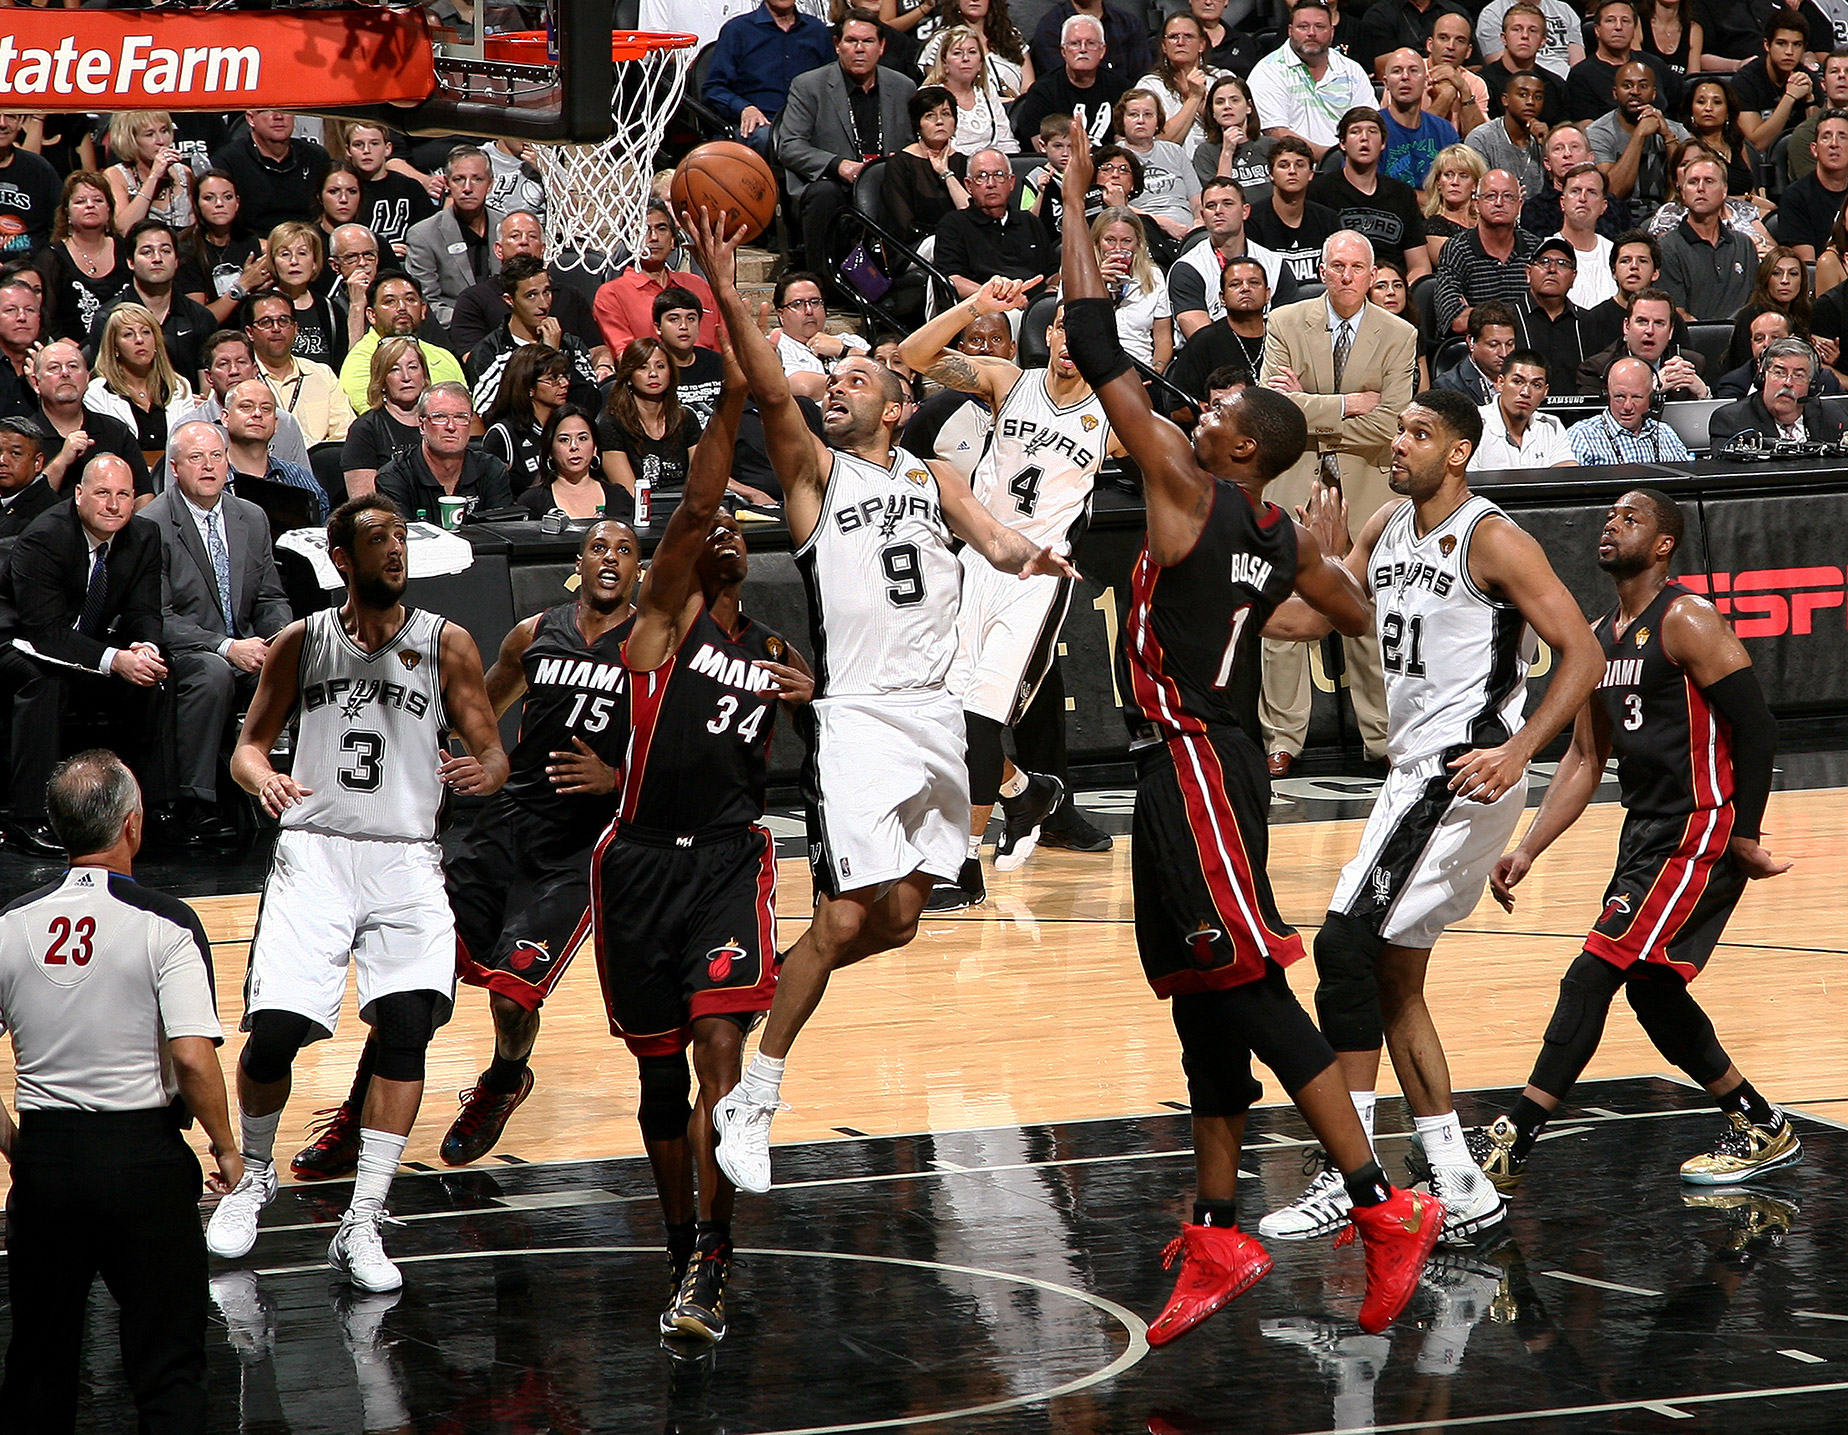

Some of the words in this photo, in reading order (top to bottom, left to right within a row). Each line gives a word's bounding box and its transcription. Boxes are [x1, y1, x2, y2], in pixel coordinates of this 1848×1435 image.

[1546, 396, 1584, 404] SAMSUNG
[1003, 418, 1096, 470] SPURS
[1008, 464, 1045, 518] 4
[879, 540, 927, 607] 9
[1231, 553, 1273, 592] BOSH
[1375, 560, 1455, 600] SPURS
[1676, 565, 1848, 639] ESP
[689, 642, 781, 692] MIAM
[1213, 604, 1250, 688] 1
[1383, 610, 1427, 680] 21
[1596, 658, 1644, 689] IAMI
[303, 678, 429, 724] SPURS
[565, 693, 615, 733] 15
[706, 694, 769, 743] 34
[1624, 693, 1644, 731] 3
[337, 729, 385, 794] 3
[44, 915, 97, 967] 23
